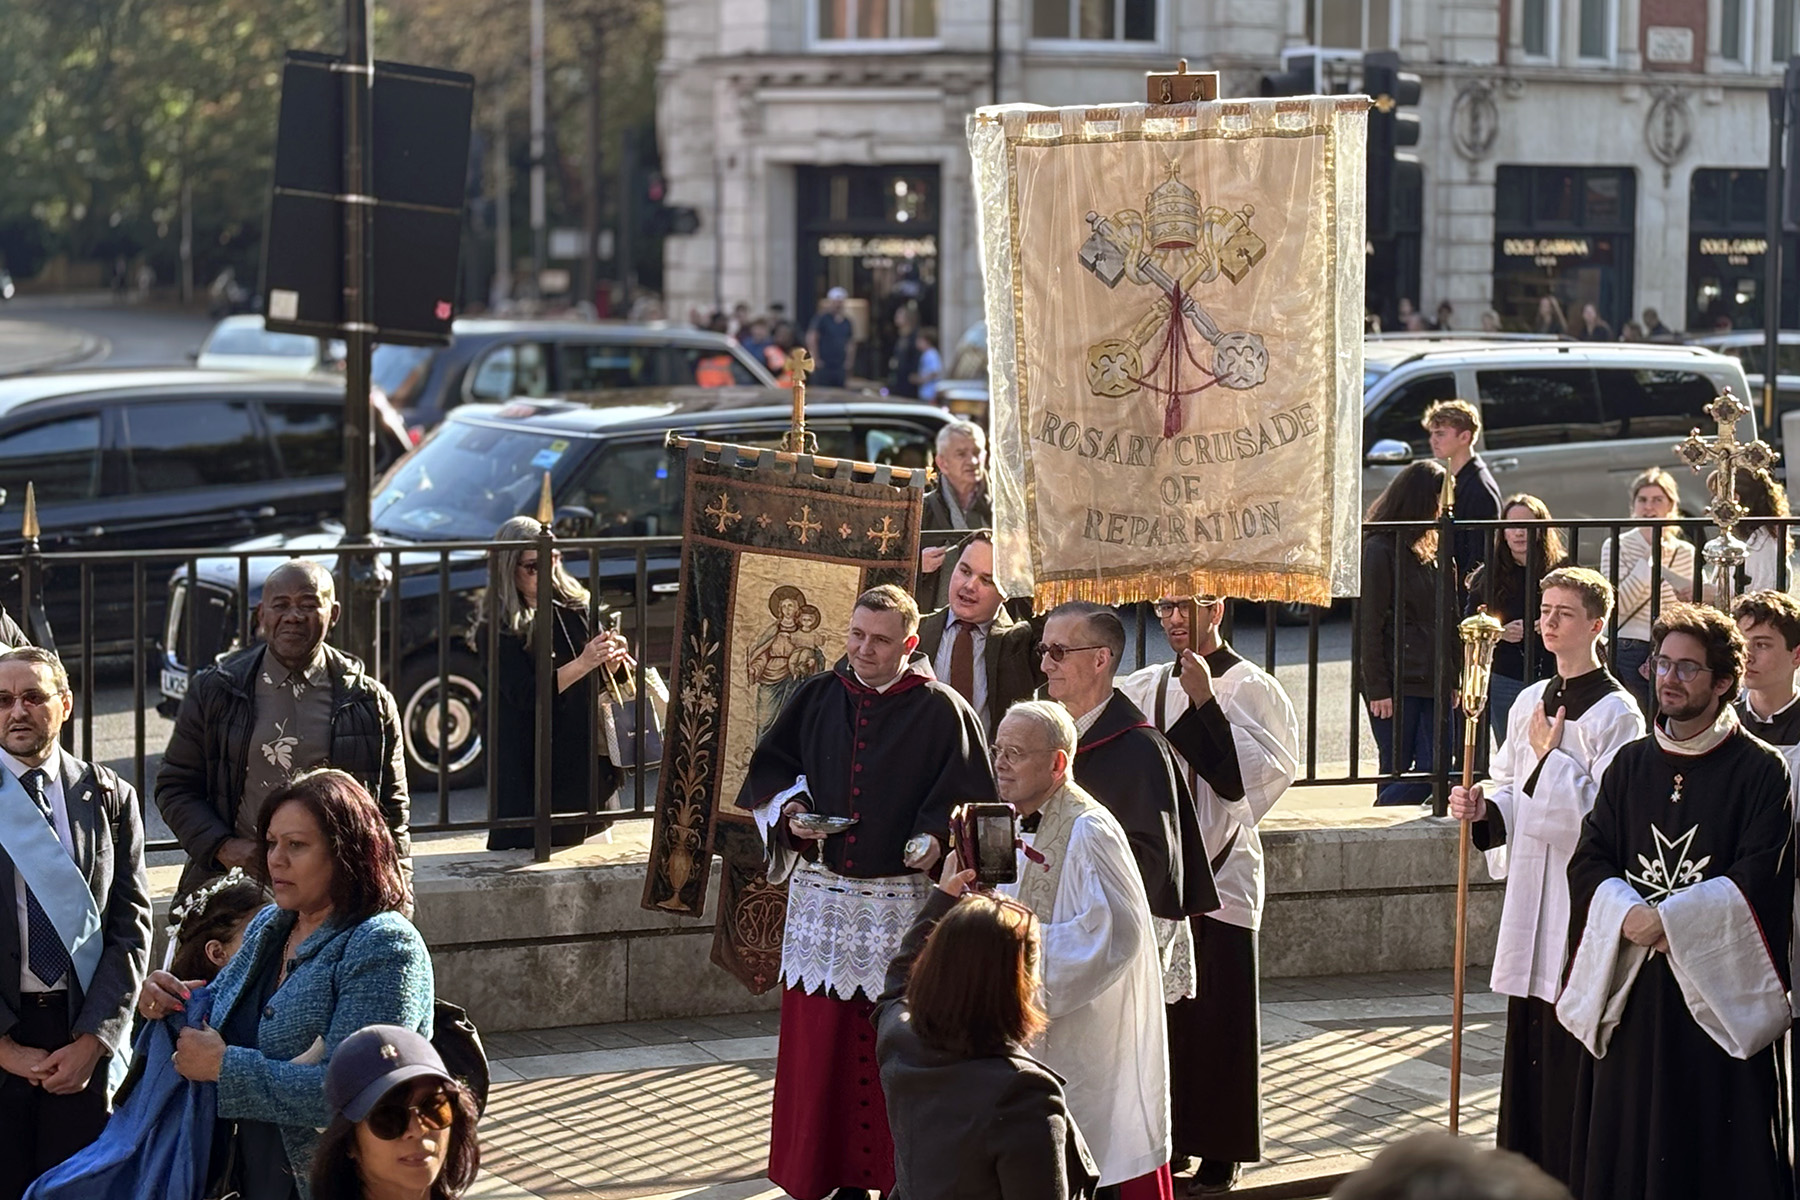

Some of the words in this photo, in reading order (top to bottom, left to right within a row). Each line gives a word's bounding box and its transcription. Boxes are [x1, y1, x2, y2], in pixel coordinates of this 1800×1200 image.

[1035, 410, 1164, 467] ROSARY
[1174, 402, 1319, 466] CRUSADE
[1159, 475, 1200, 506] OF
[1082, 500, 1282, 547] REPARATION
